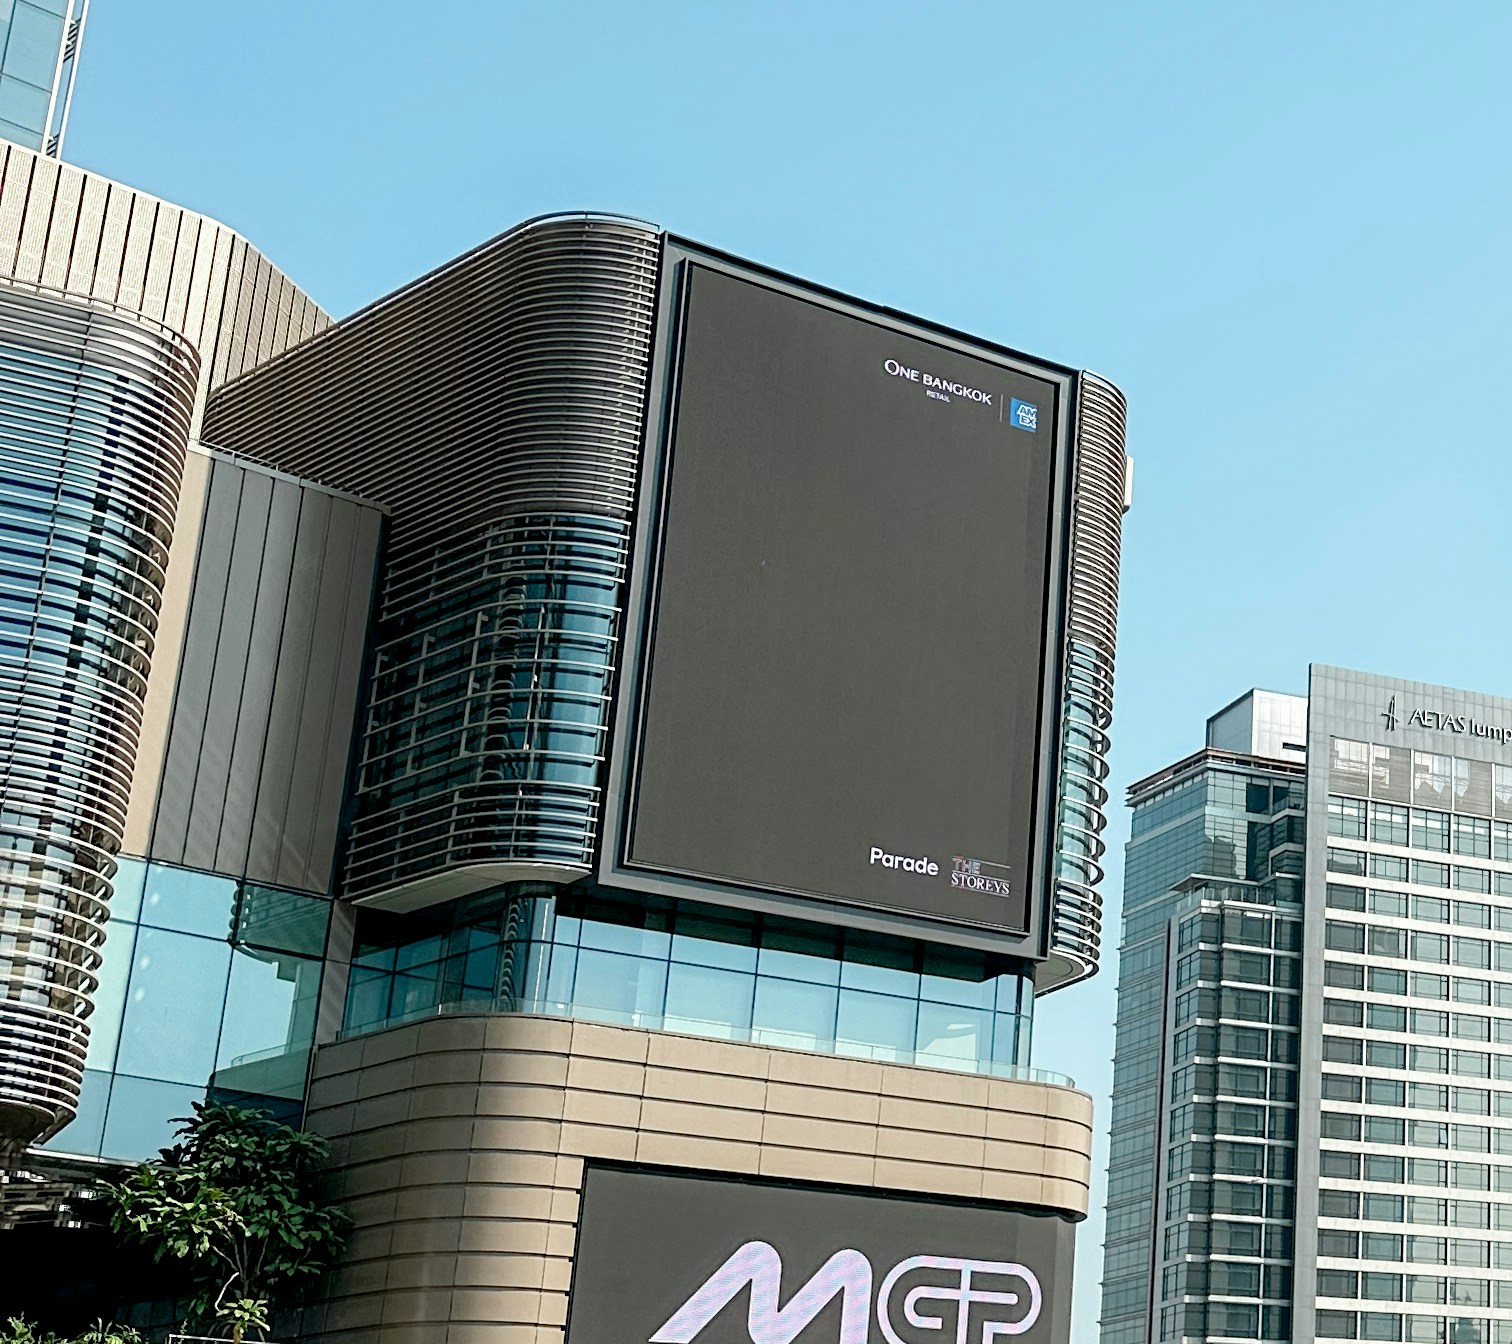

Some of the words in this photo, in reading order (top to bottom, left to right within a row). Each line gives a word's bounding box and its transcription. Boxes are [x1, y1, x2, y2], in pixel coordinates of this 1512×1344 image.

[884, 359, 919, 381] ONE
[922, 374, 992, 405] BANGKOK
[1408, 708, 1467, 733] AETAS
[870, 847, 939, 876] Parade
[952, 857, 981, 874] THE
[951, 873, 1010, 895] STOREYS
